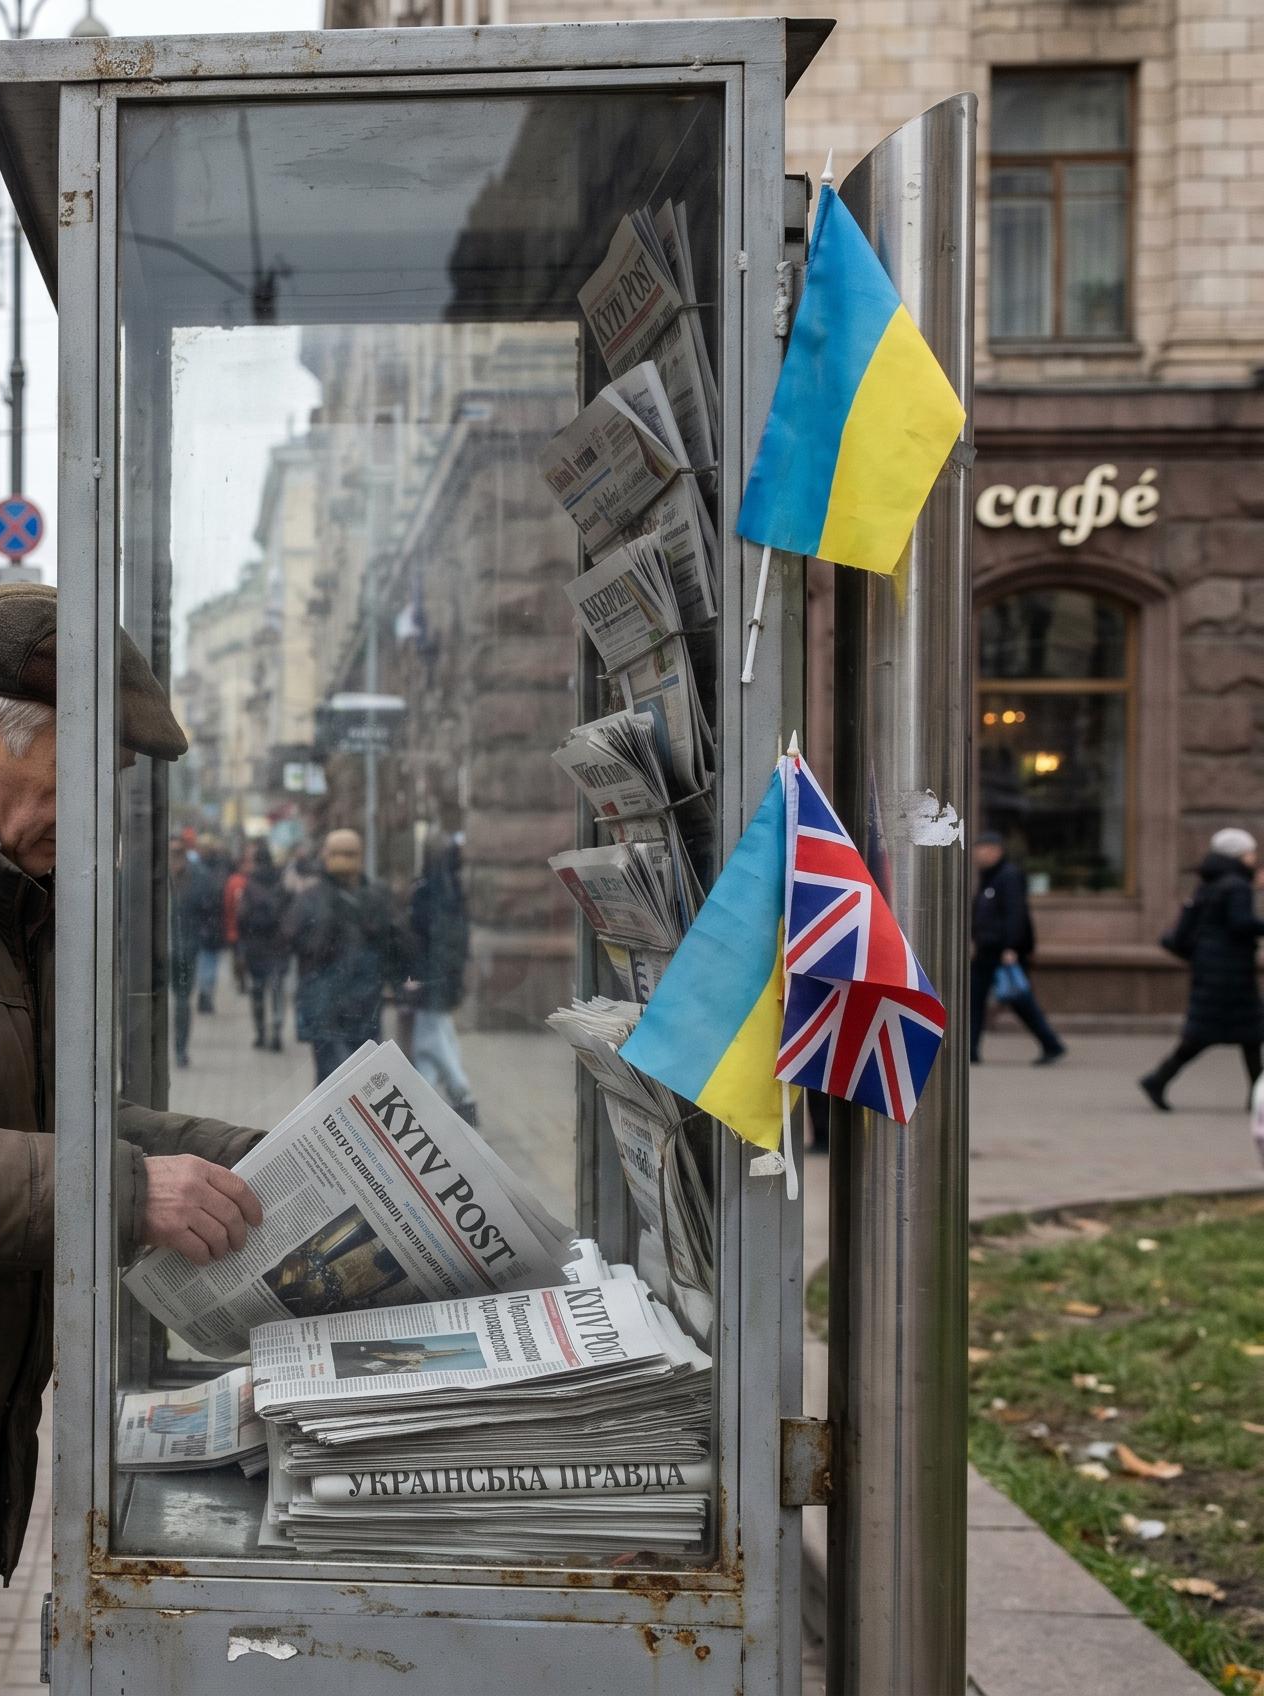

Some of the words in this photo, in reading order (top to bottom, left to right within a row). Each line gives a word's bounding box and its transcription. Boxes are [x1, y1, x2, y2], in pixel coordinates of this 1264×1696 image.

[619, 251, 657, 314] POST
[369, 1085, 451, 1176] KYIV
[435, 1173, 516, 1267] POST
[564, 1286, 613, 1329] KYIV
[559, 1463, 688, 1492] ПРАВДА
